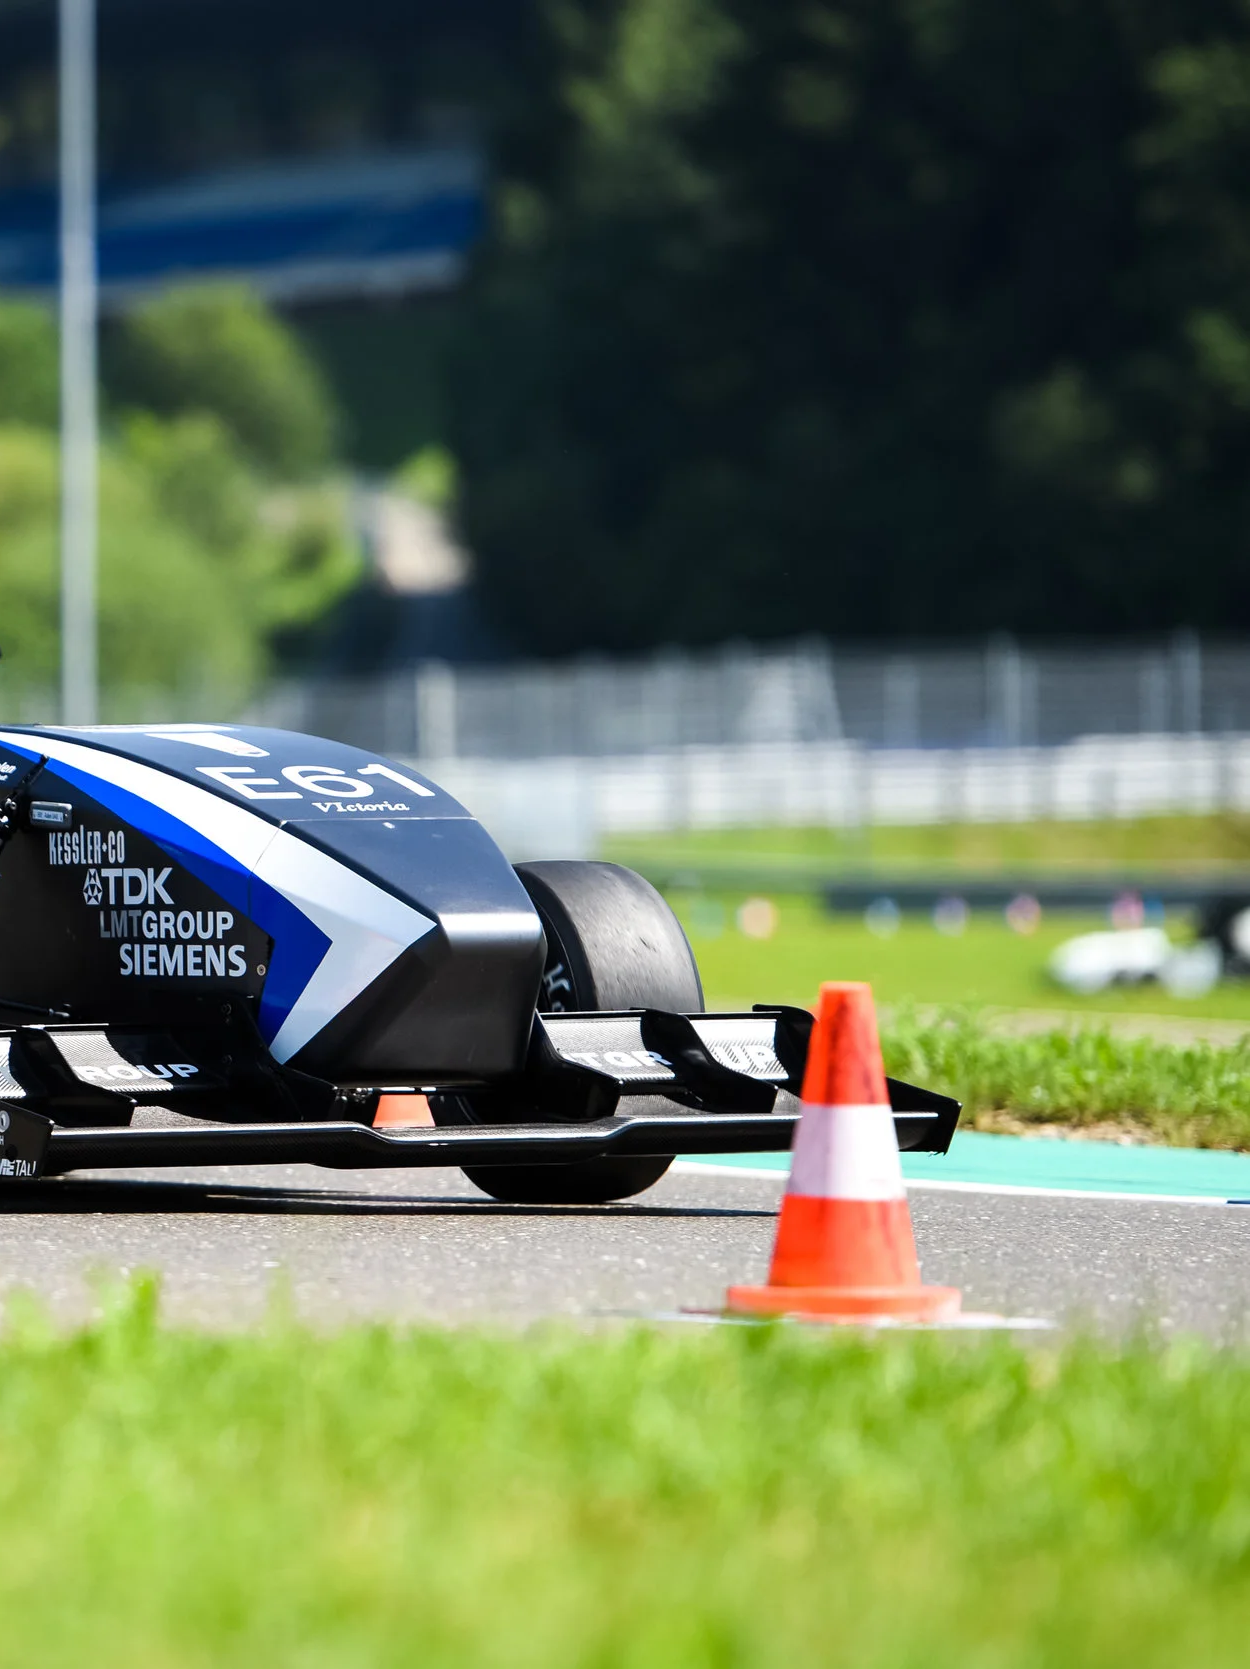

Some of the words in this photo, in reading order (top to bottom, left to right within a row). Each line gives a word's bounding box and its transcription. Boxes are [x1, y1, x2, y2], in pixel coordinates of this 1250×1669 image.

[196, 763, 436, 800] E61
[101, 867, 175, 905] TDK
[119, 943, 247, 977] SIEMENS
